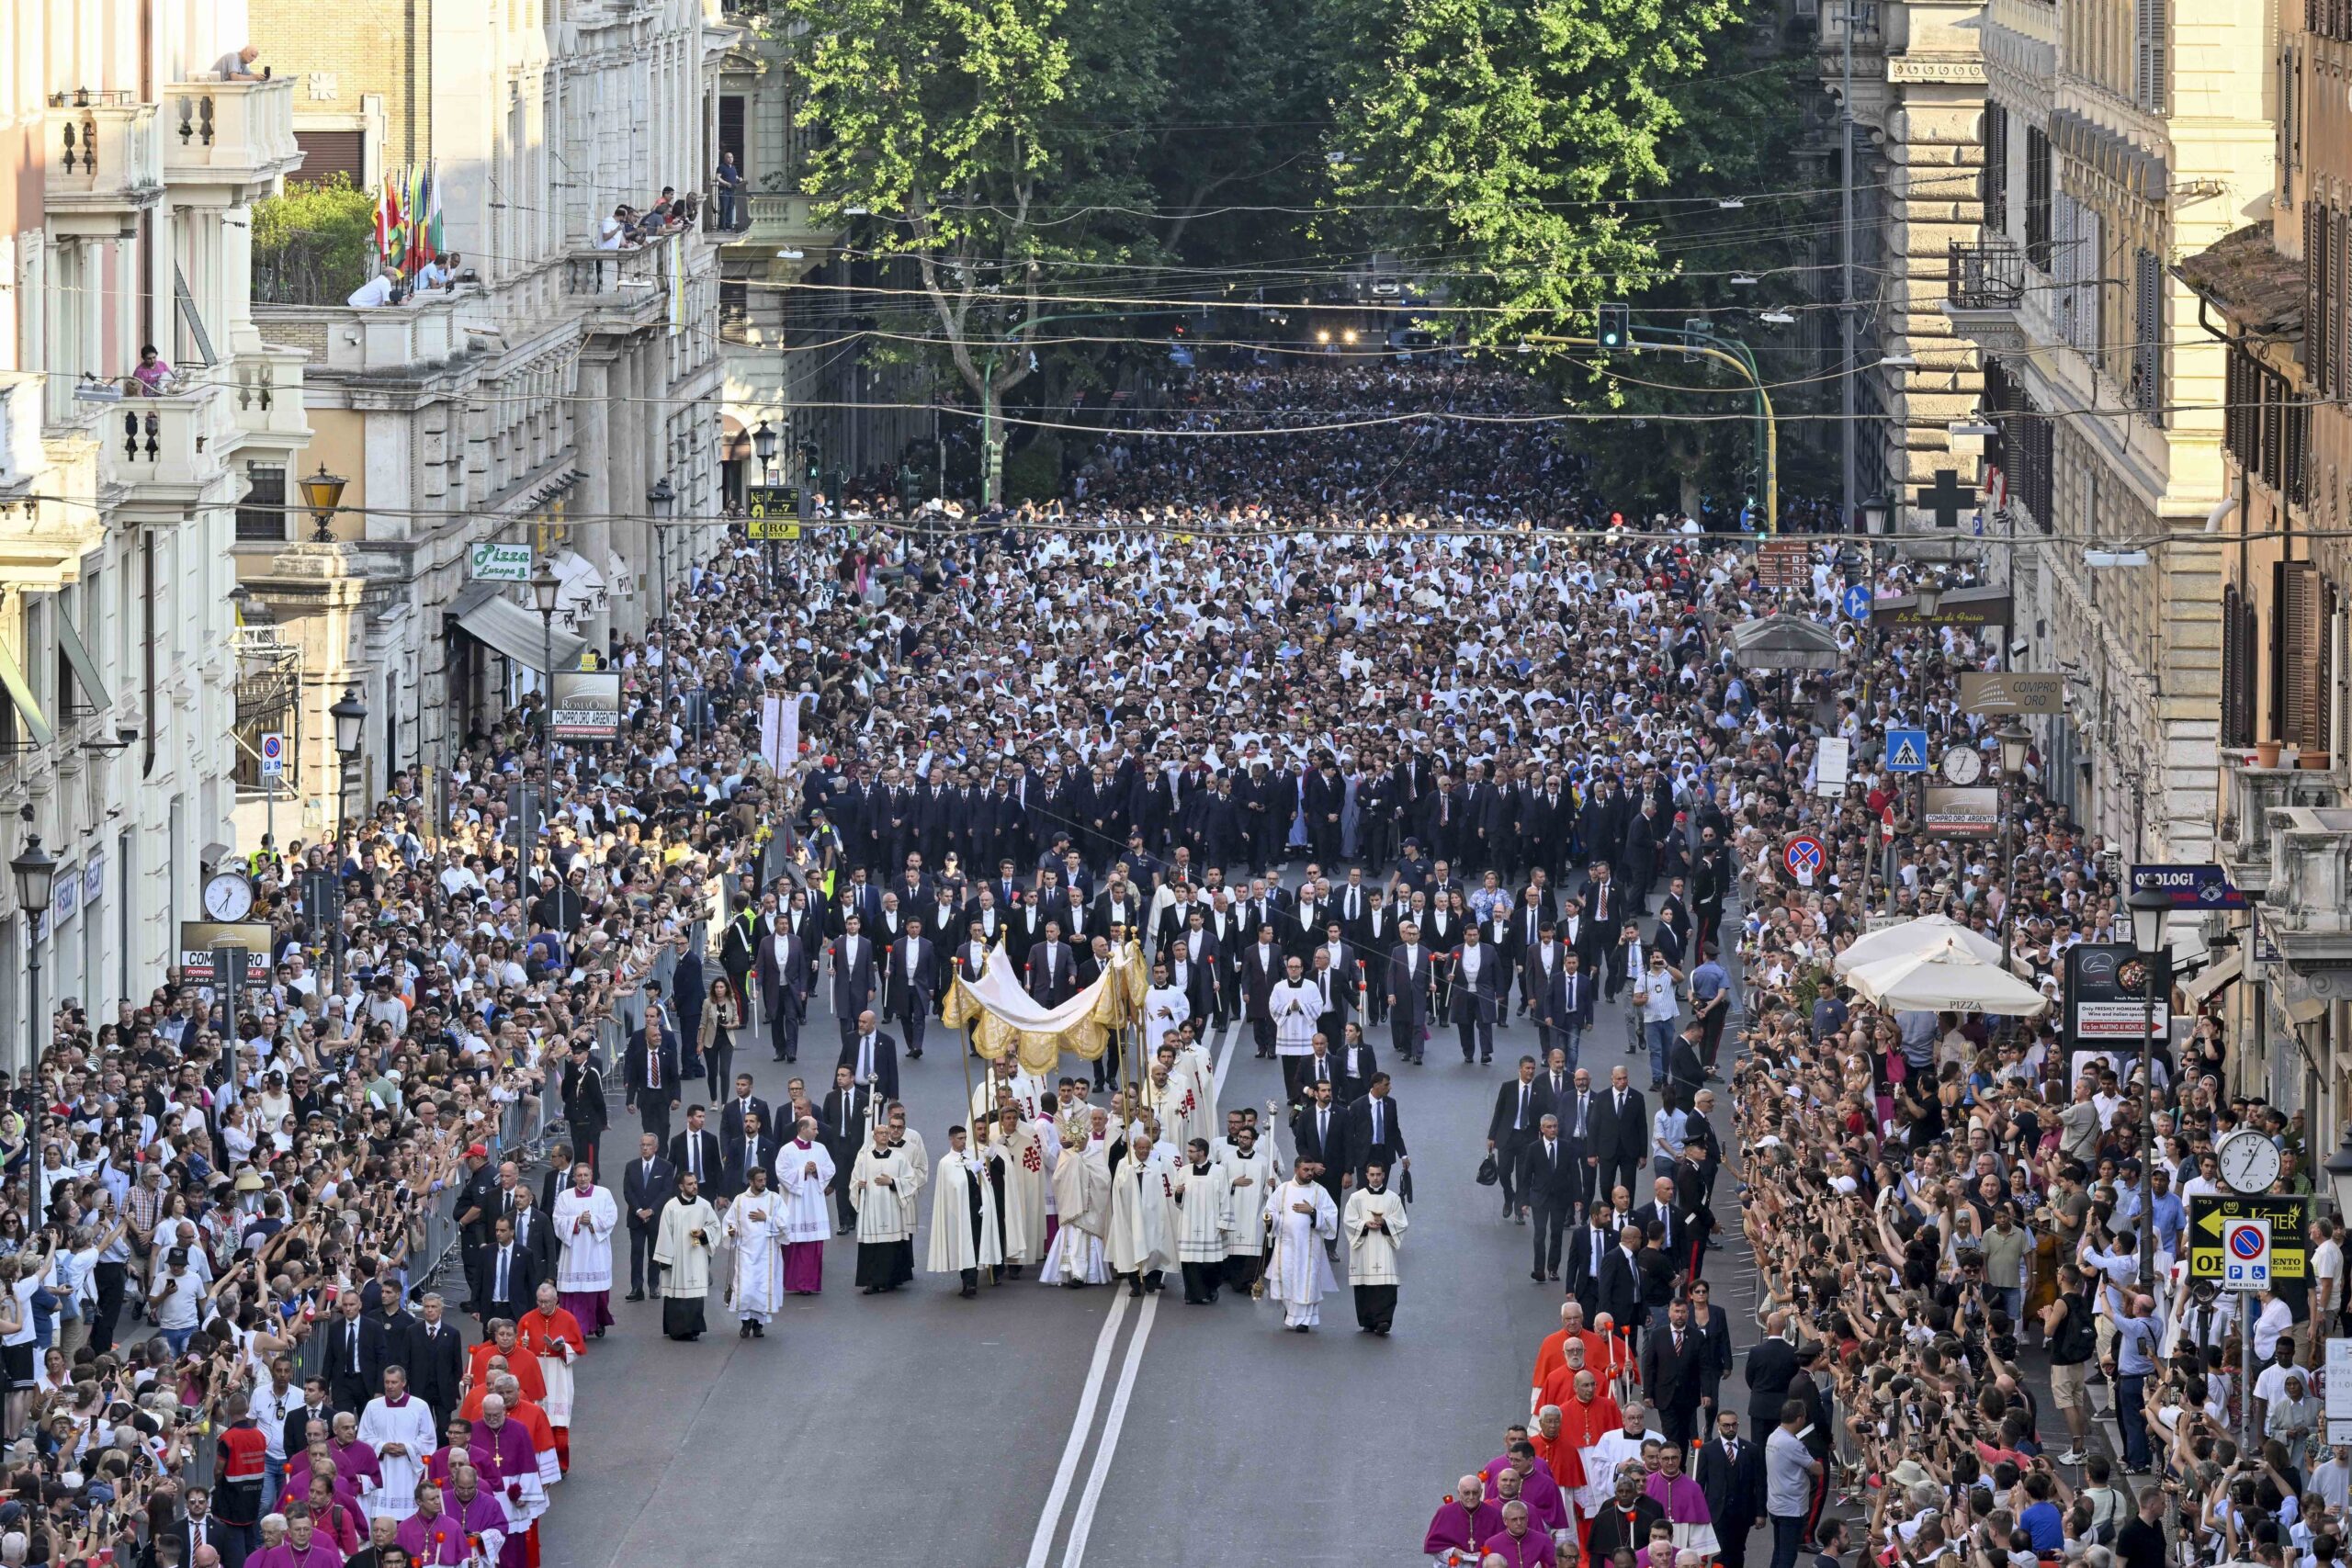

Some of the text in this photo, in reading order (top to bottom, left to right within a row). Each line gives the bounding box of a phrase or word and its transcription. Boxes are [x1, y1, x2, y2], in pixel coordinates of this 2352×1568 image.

[751, 491, 773, 503] KETR
[473, 544, 530, 567] Pizza
[477, 564, 515, 578] Europa
[2013, 682, 2058, 693] COMPRO
[2023, 694, 2047, 706] ORO
[555, 710, 578, 725] COMPRO
[2135, 873, 2194, 886] OOLOGI
[1950, 1000, 1983, 1010] PIZZA
[2245, 1135, 2257, 1146] 12
[2222, 1156, 2230, 1168] 9
[2270, 1157, 2277, 1168] 3
[2245, 1179, 2253, 1190] 6
[2271, 1258, 2301, 1266] ENTO
[2232, 1267, 2241, 1278] P
